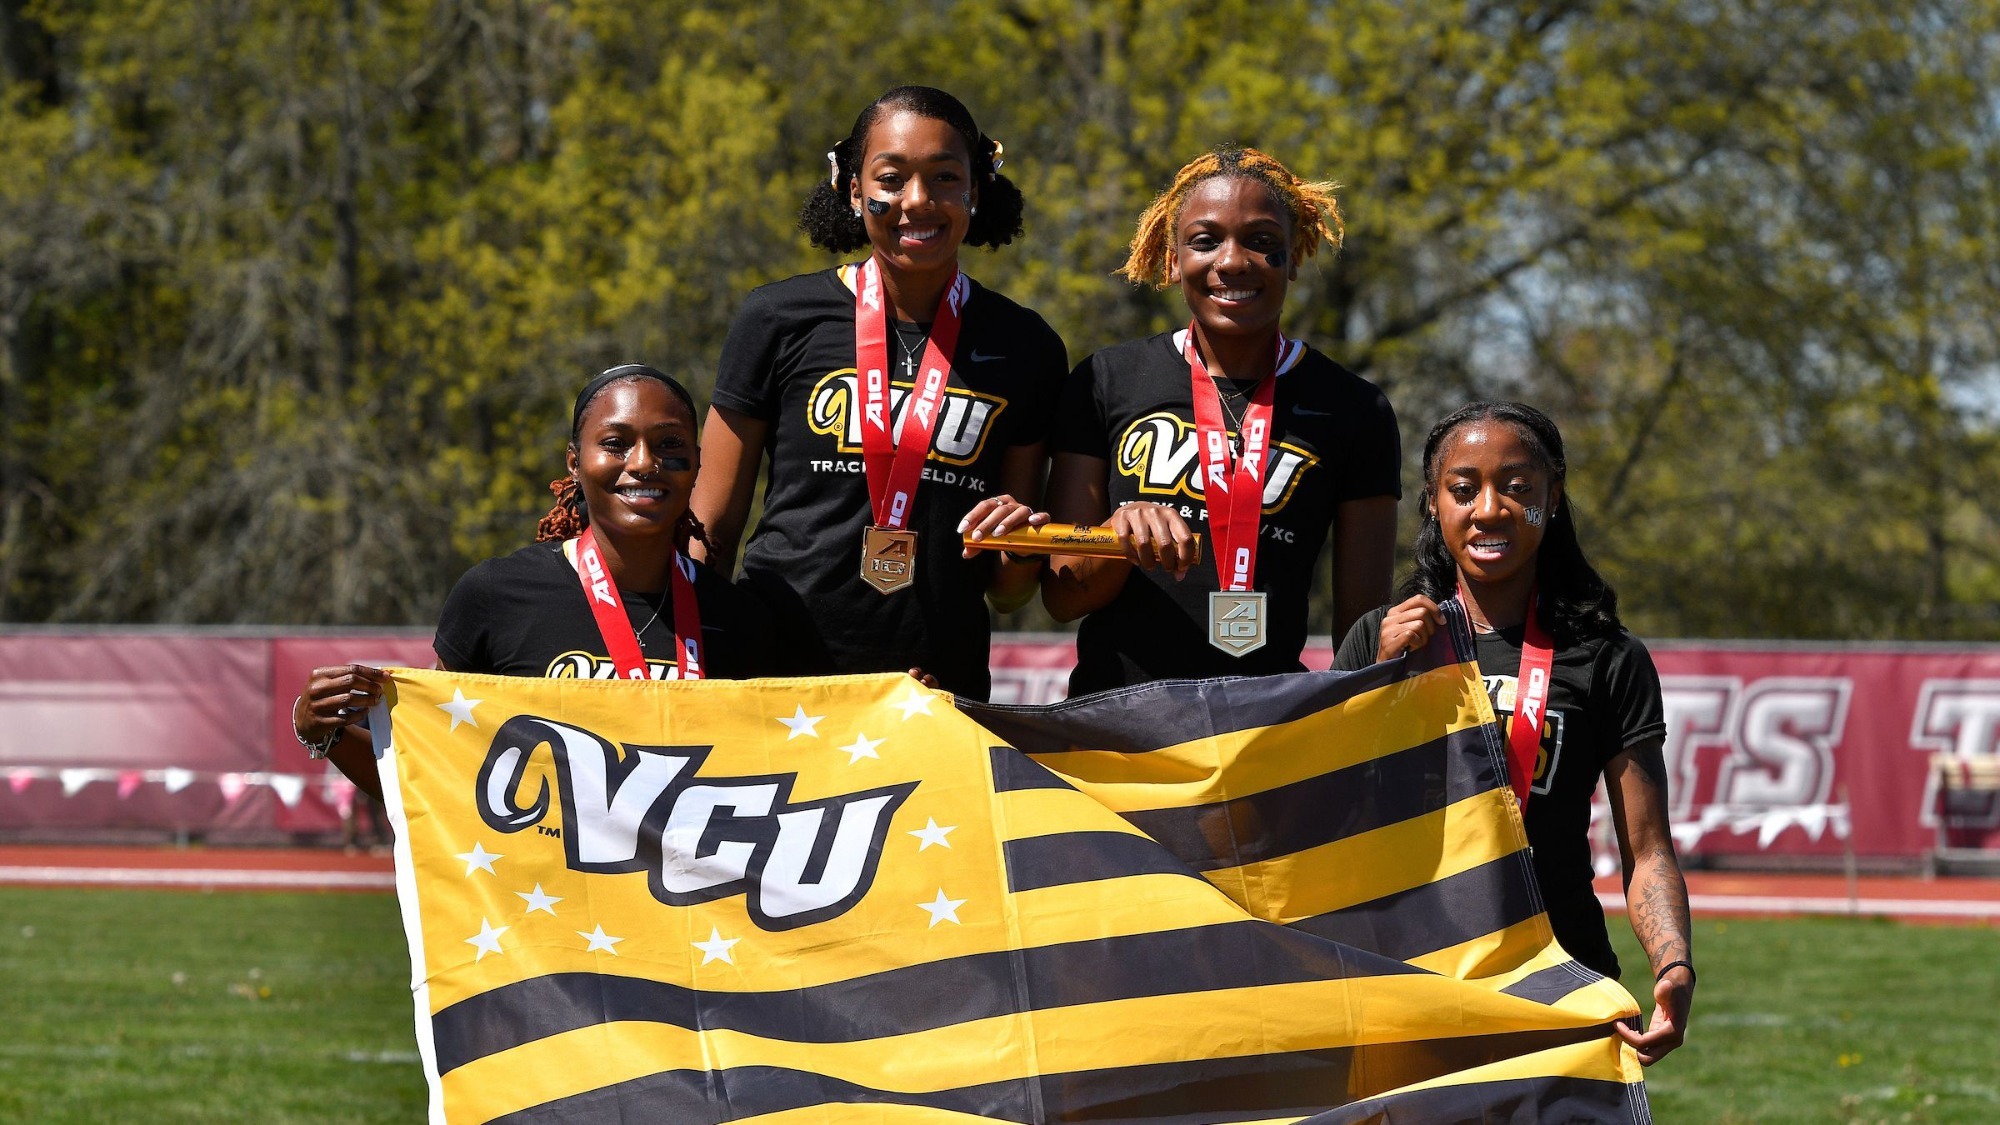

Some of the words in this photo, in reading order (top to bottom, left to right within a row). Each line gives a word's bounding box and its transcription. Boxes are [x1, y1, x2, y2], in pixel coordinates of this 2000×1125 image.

[865, 369, 886, 433] A10
[913, 367, 943, 431] A10
[810, 460, 867, 473] TRAC
[1206, 430, 1229, 494] A10
[1242, 418, 1266, 483] A10
[887, 491, 908, 528] 10
[1271, 526, 1295, 544] XC
[583, 547, 618, 608] A10
[1229, 547, 1250, 591] 10
[1216, 621, 1257, 638] 10
[1521, 667, 1545, 732] A10
[475, 713, 923, 932] VCU
